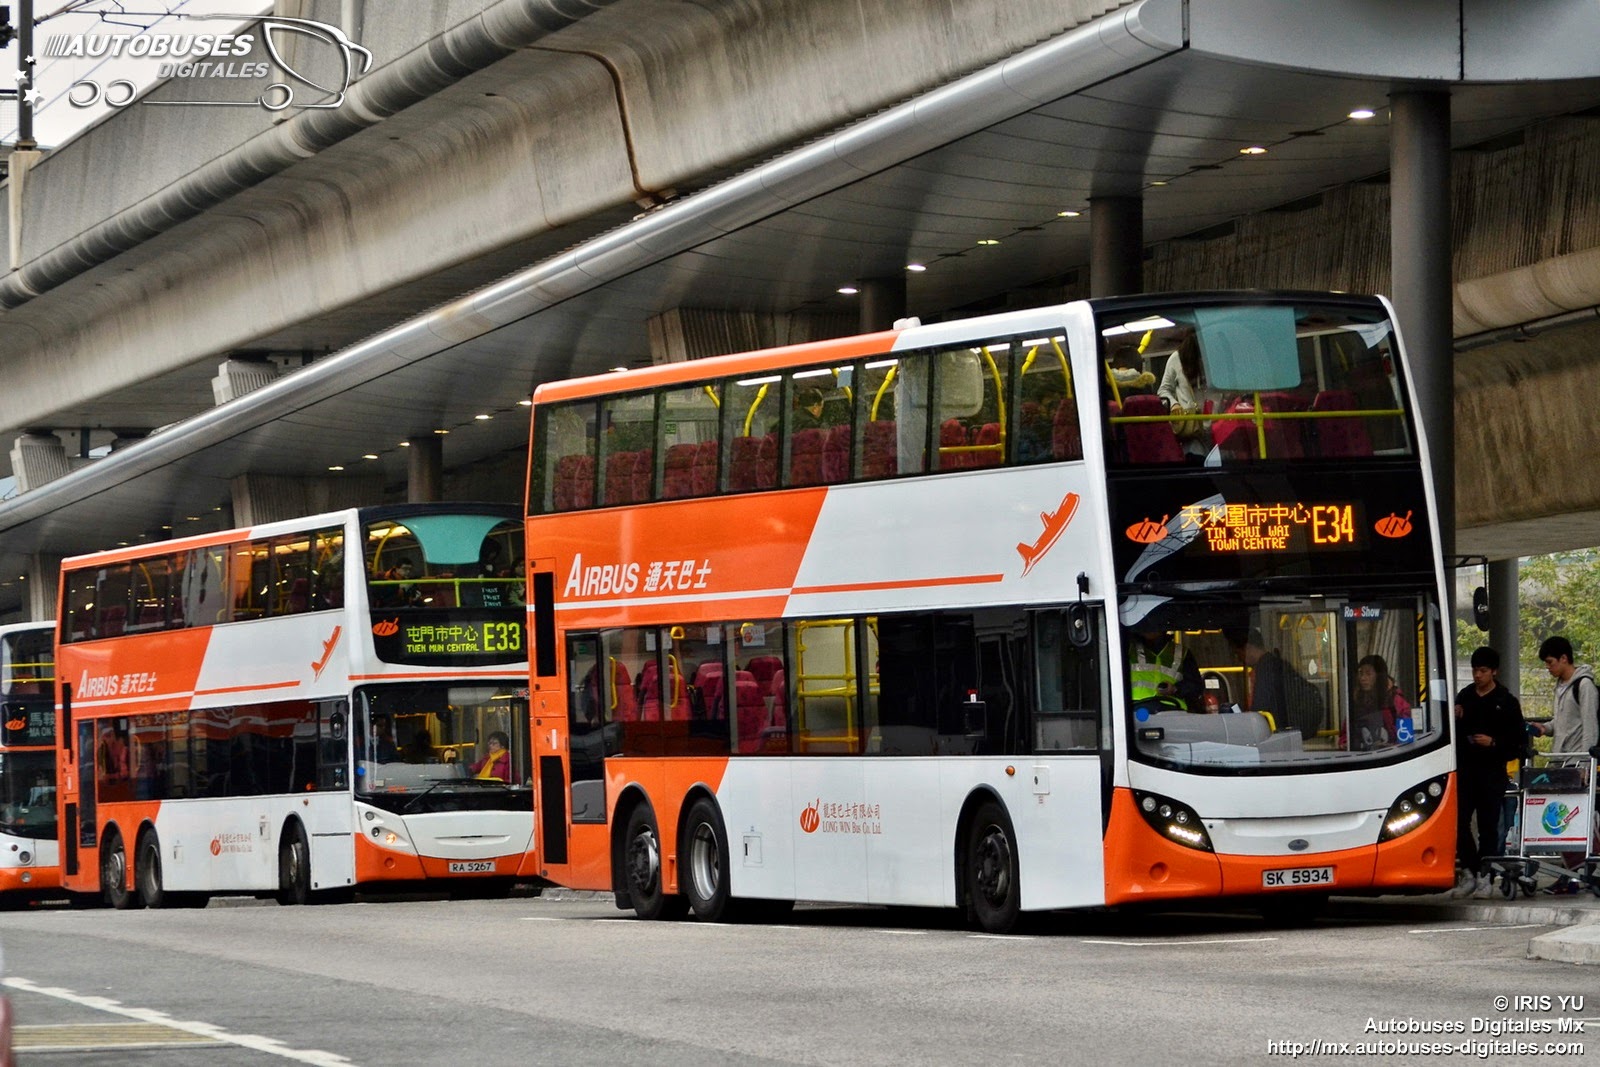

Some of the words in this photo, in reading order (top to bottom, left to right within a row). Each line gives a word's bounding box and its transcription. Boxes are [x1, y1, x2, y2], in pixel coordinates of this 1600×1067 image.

[1181, 502, 1311, 528] 天水圍市中心
[1312, 504, 1354, 543] E34
[1205, 526, 1226, 539] TIN
[1233, 525, 1261, 538] SHUI
[1268, 524, 1290, 537] WAI
[1208, 538, 1239, 551] TOWN
[1242, 536, 1286, 550] CENTRE
[643, 559, 712, 592] 通天巴士
[406, 625, 479, 643] 屯門市中心
[483, 622, 520, 652] E33
[406, 643, 427, 653] TUEN
[428, 643, 445, 653] MUN
[446, 642, 480, 653] CENTRAL
[120, 672, 157, 695] 通天巴士
[822, 820, 838, 834] LONG
[839, 821, 851, 834] WIN
[852, 821, 861, 834] Bus
[452, 863, 465, 872] RA
[467, 862, 492, 872] 5267
[1266, 872, 1285, 886] SK
[1291, 869, 1330, 884] 5934
